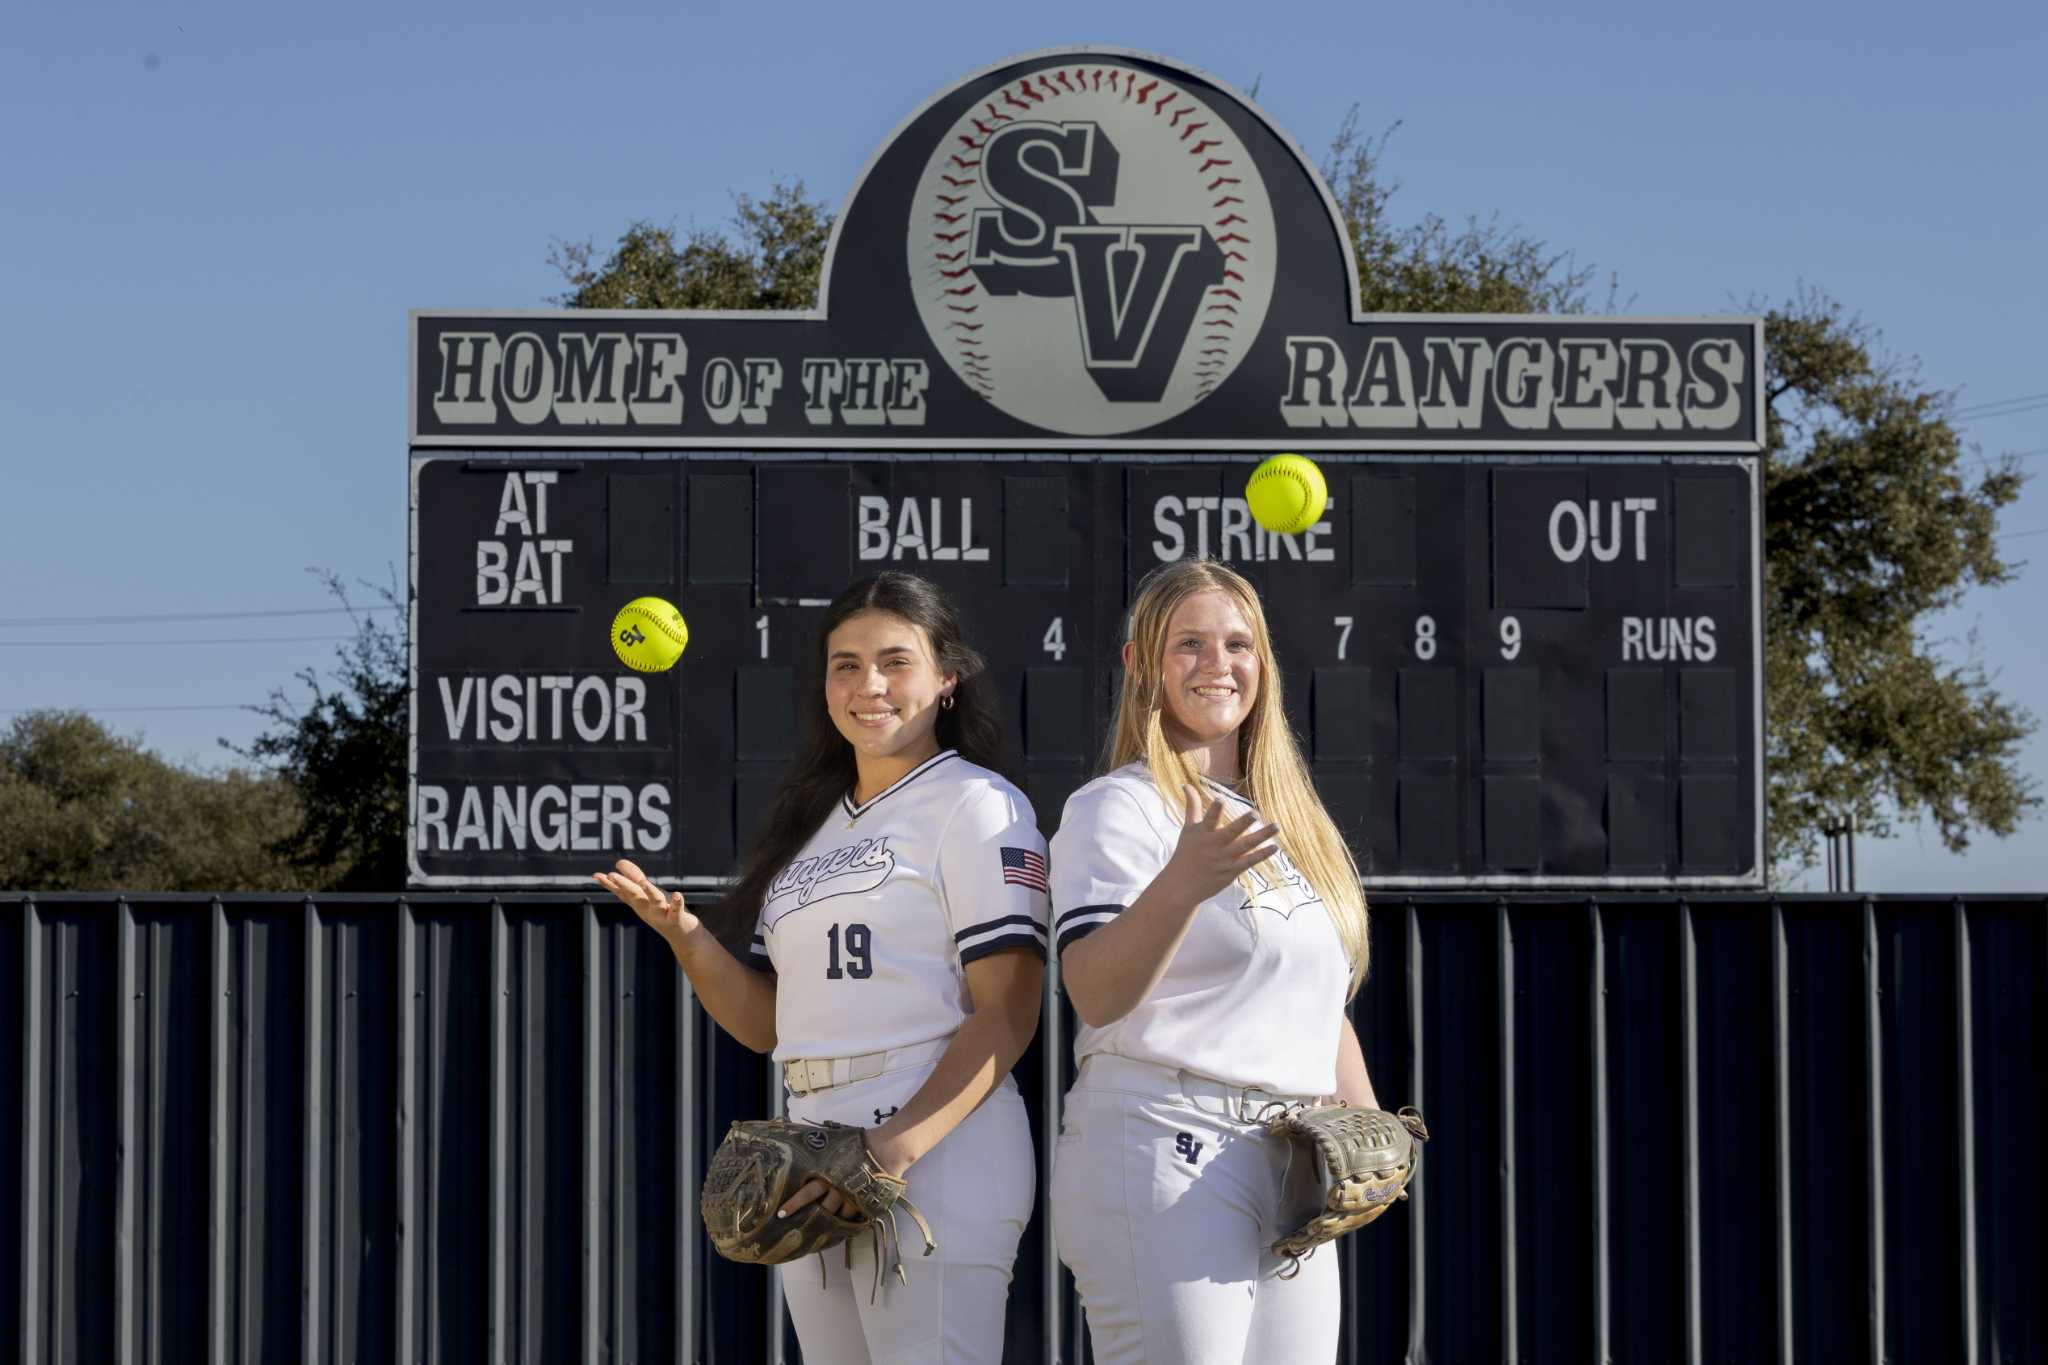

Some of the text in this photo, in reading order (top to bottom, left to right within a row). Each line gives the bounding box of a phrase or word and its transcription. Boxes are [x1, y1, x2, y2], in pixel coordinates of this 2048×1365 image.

[968, 120, 1226, 403] SV
[433, 331, 1746, 430] HOME OF THE RANGERS
[494, 471, 558, 536] AT
[858, 495, 990, 562] BALL
[1548, 497, 1657, 564] OUT
[476, 540, 573, 606] BAT
[619, 624, 646, 647] SV
[756, 615, 1717, 662] 1 4 7 8 9 RUNS
[438, 674, 648, 743] VISITOR
[417, 783, 672, 852] RANGERS
[767, 837, 890, 905] angers
[826, 923, 873, 979] 19
[1175, 1131, 1203, 1165] SV
